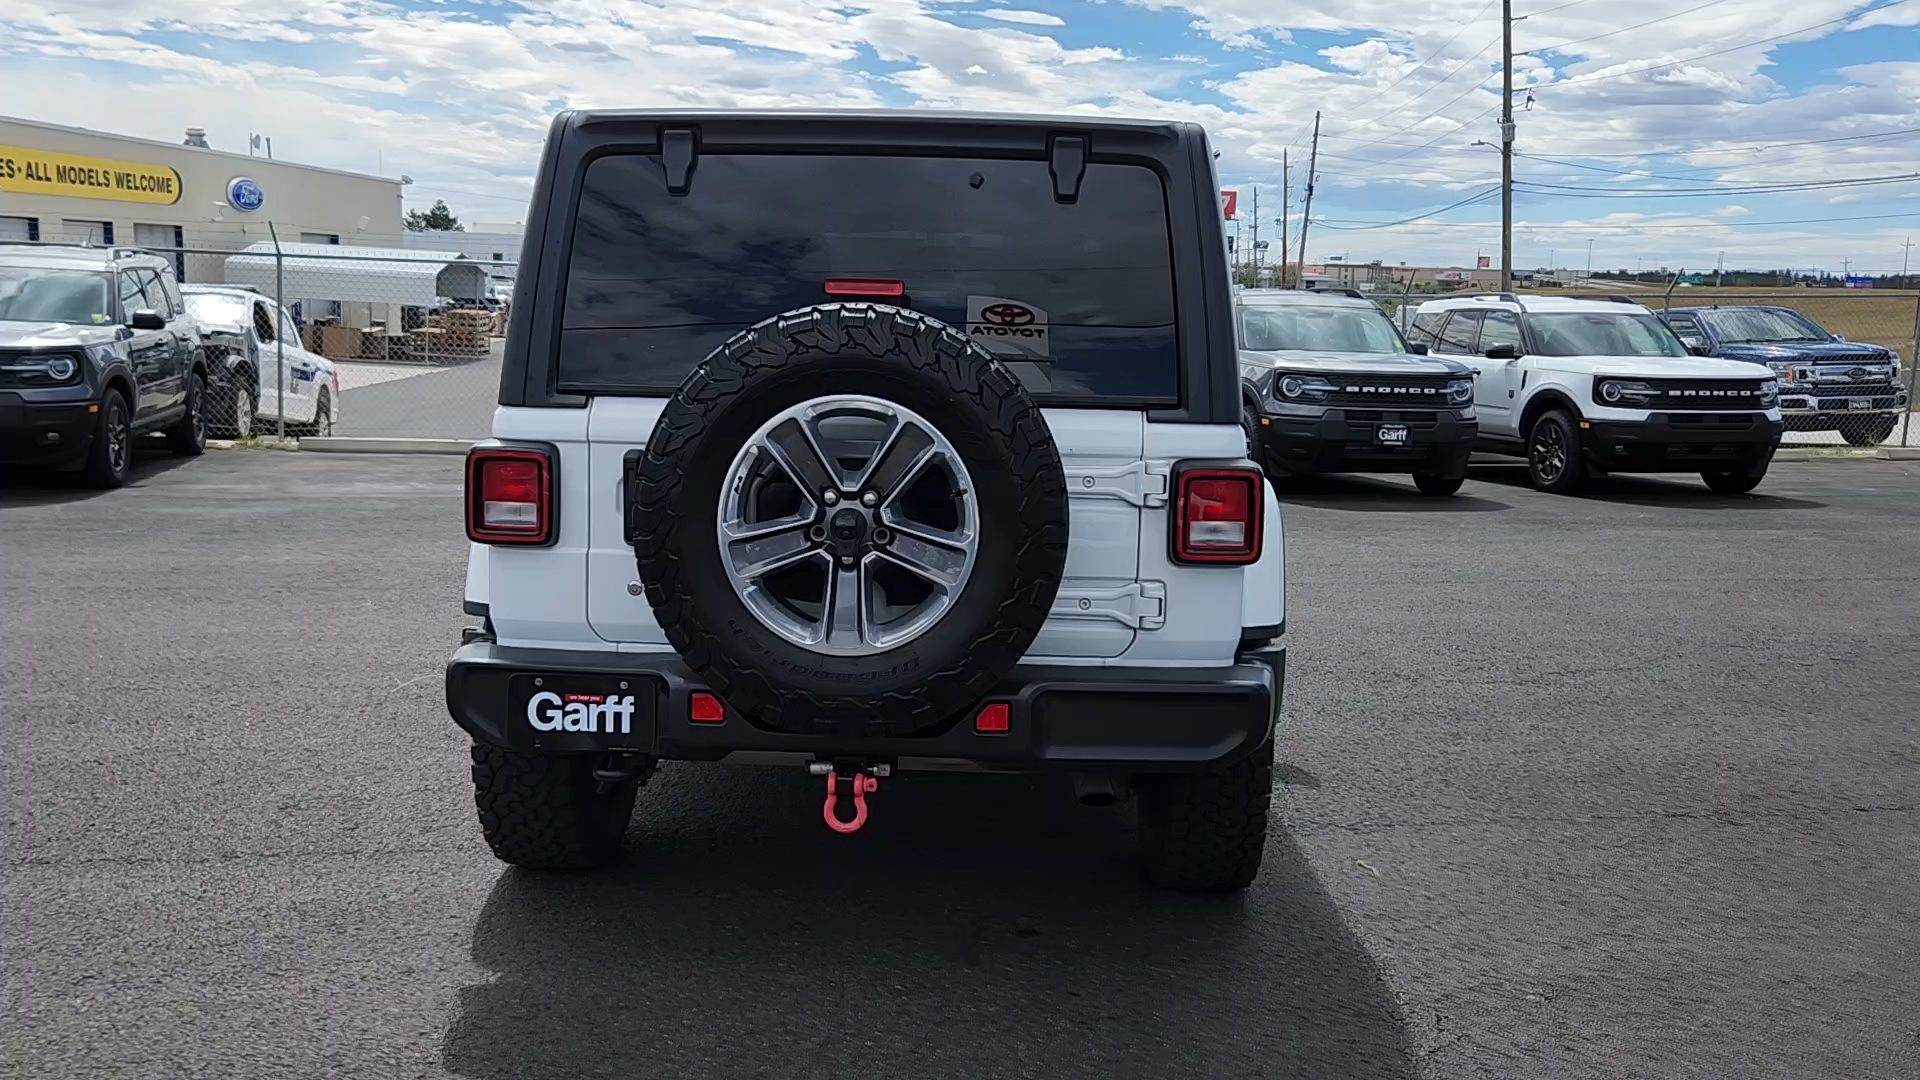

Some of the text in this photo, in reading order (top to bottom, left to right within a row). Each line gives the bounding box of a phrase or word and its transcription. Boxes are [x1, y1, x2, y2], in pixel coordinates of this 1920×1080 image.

[25, 161, 52, 183] ALL
[56, 164, 111, 189] MODELS
[114, 170, 173, 194] WELCOME
[1346, 385, 1436, 394] BRONCO
[1378, 428, 1407, 441] Garff
[527, 691, 635, 734] Garff
